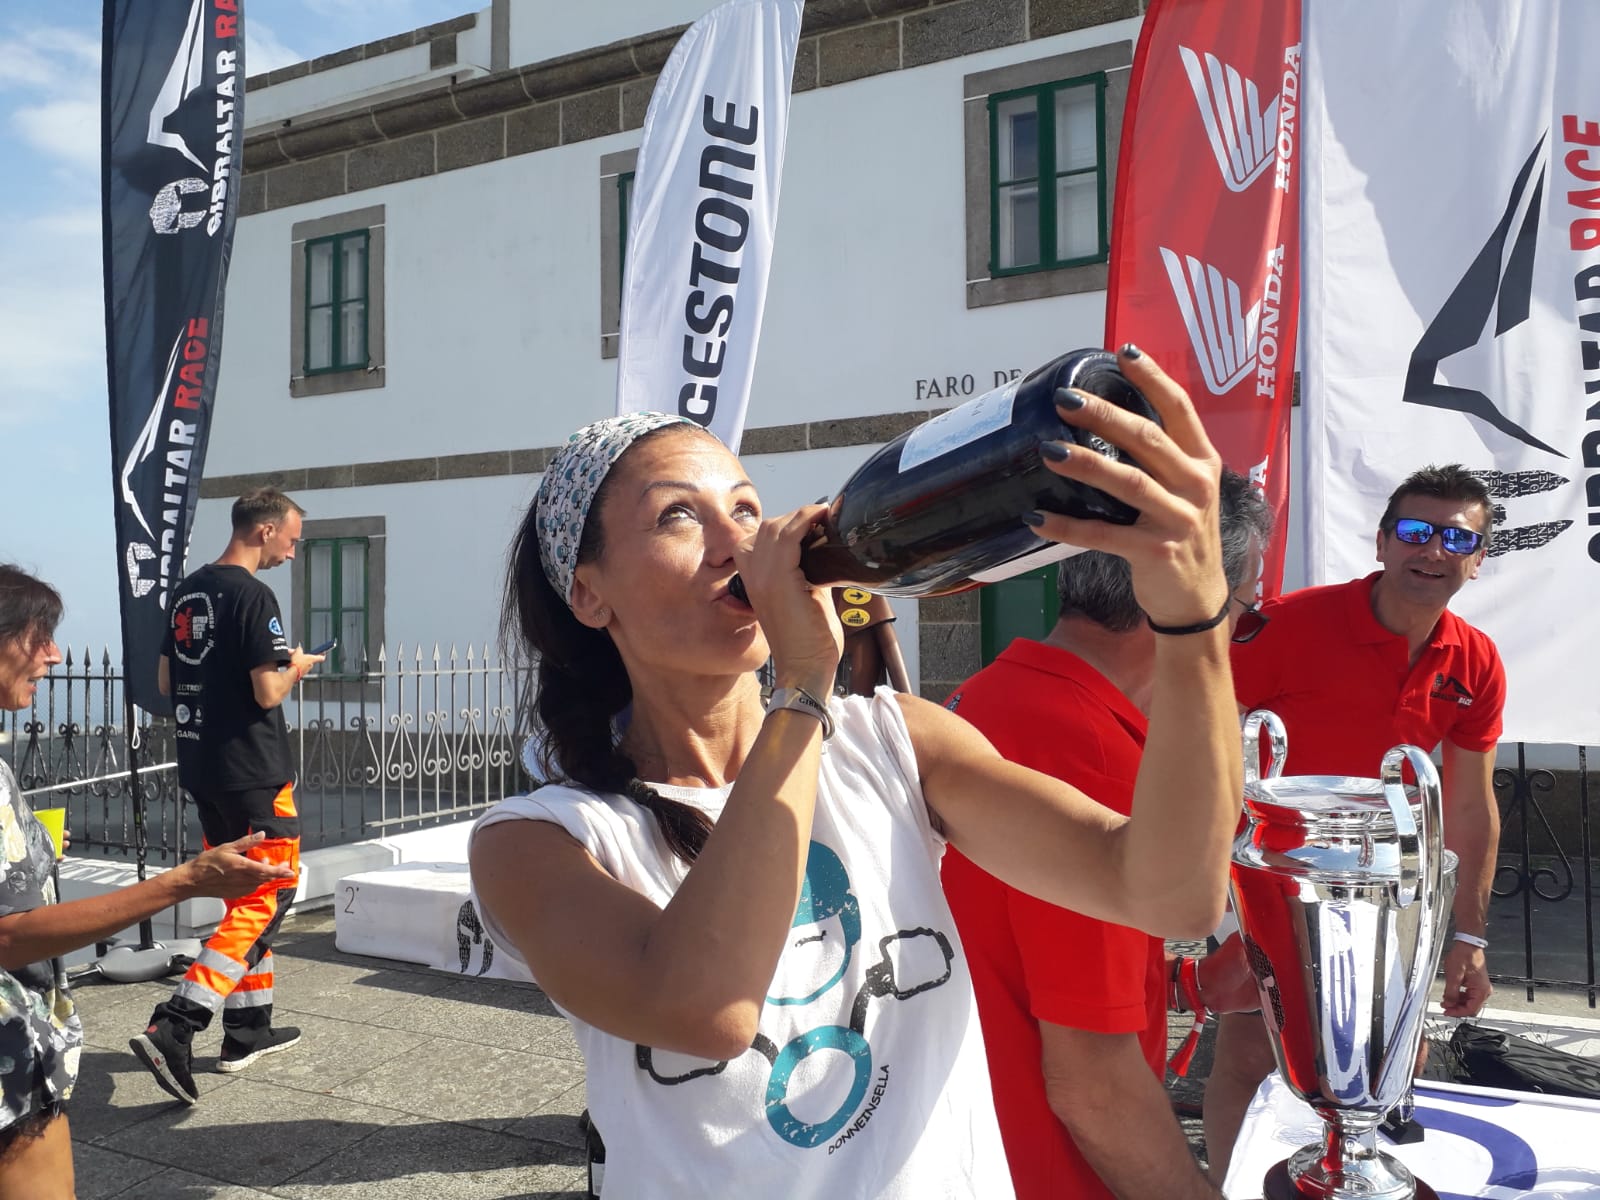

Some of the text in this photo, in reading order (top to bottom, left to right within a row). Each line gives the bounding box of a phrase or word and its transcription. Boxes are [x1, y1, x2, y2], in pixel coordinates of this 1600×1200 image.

[207, 50, 237, 237] GIBRALTAR
[1274, 42, 1302, 193] HONDA
[678, 95, 759, 427] GESTONE
[1256, 243, 1285, 399] HONDA
[174, 317, 208, 410] RACE
[916, 374, 974, 400] FARO
[827, 1064, 890, 1155] DONNEINSELLA
